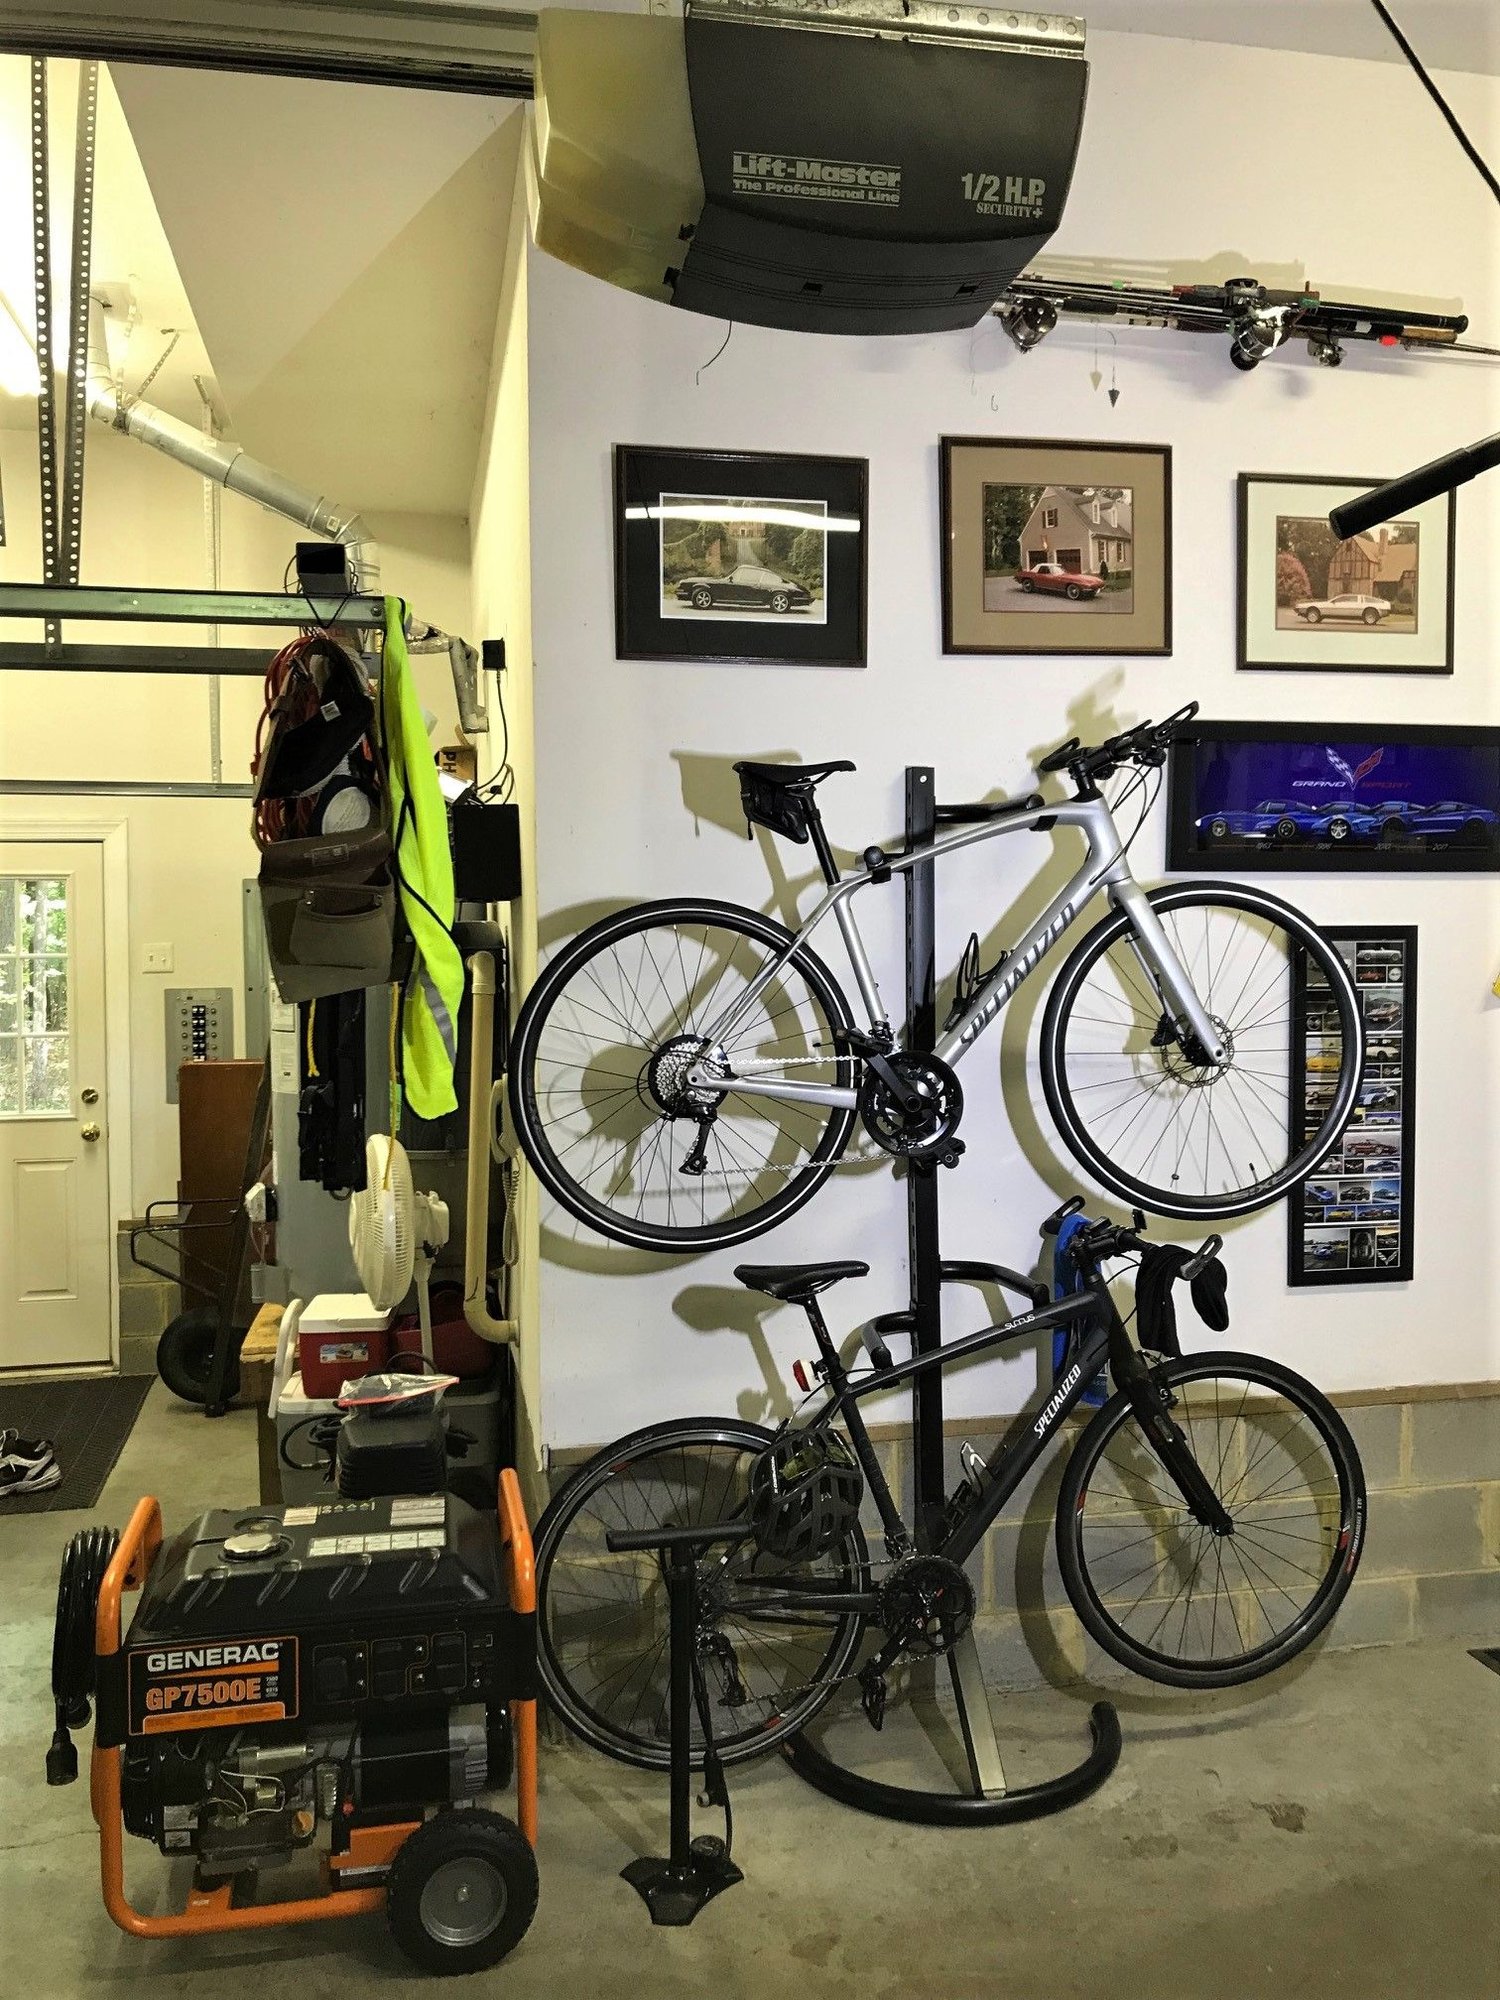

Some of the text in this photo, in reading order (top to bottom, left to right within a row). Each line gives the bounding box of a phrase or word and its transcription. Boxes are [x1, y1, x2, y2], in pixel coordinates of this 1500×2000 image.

[732, 154, 901, 187] Lift-Master
[732, 178, 900, 203] The Professional Line
[961, 172, 1001, 202] 1/2
[1292, 780, 1346, 789] GRAND
[1034, 1364, 1082, 1439] SPECIALIZED
[147, 1642, 280, 1673] GENERAC
[145, 1677, 262, 1711] GP7500E
